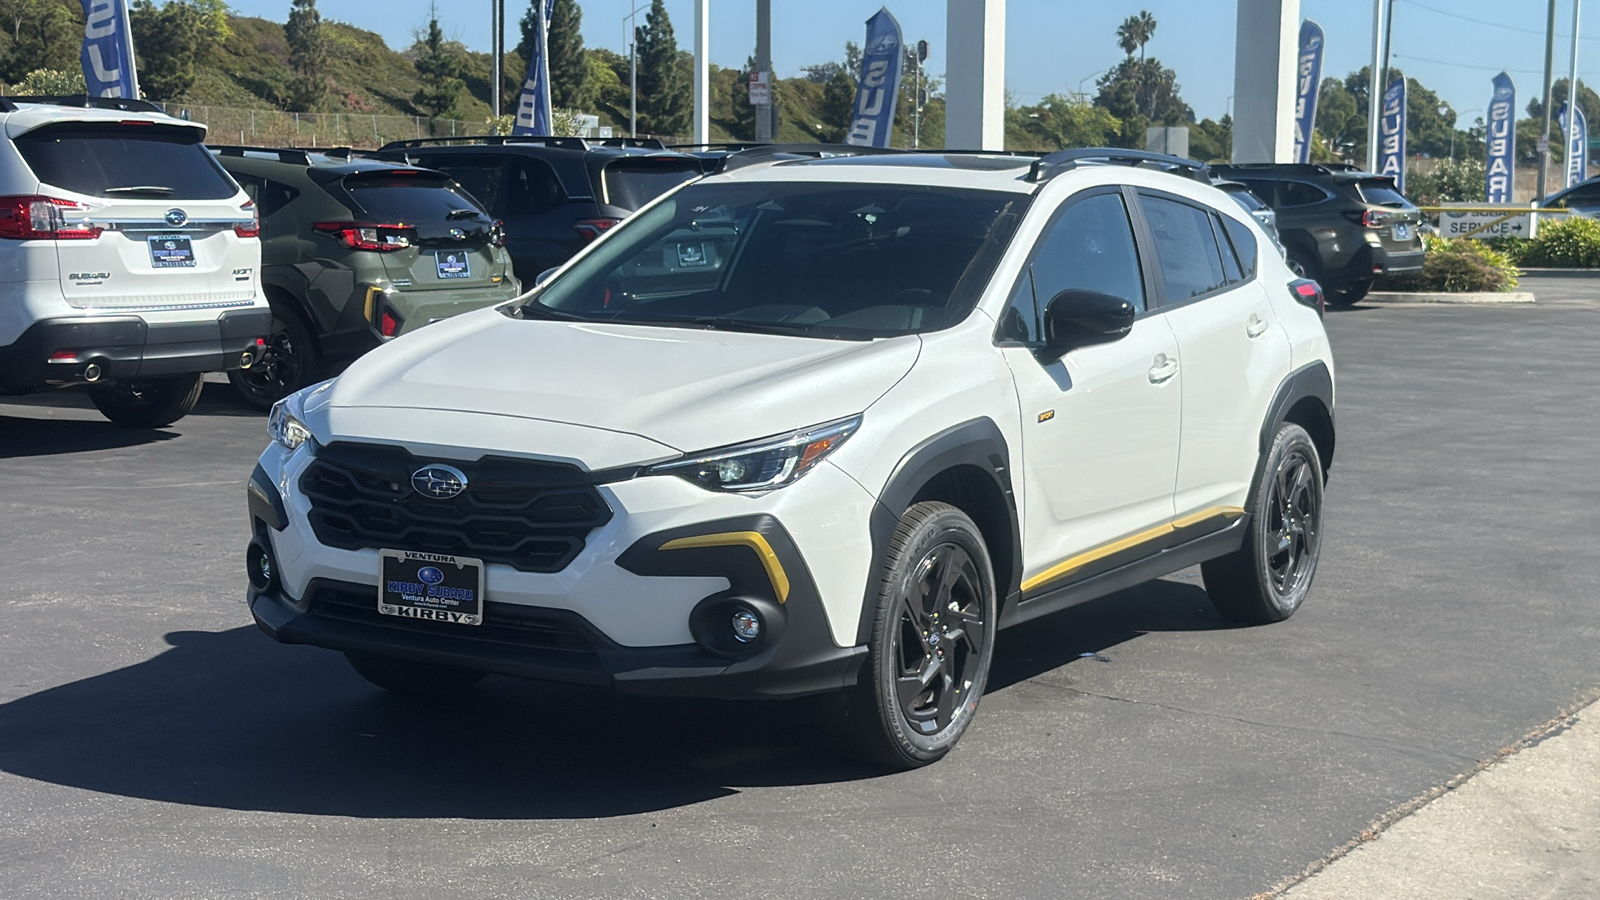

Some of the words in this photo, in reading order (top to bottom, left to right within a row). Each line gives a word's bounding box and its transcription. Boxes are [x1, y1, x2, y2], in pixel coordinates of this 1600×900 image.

[405, 552, 456, 563] VENTURA
[388, 581, 424, 595] KIRBY
[427, 585, 474, 601] SUBARU
[401, 593, 425, 602] Ventura
[425, 596, 440, 604] Auto
[440, 597, 460, 606] Center
[398, 606, 463, 623] KIRBY
